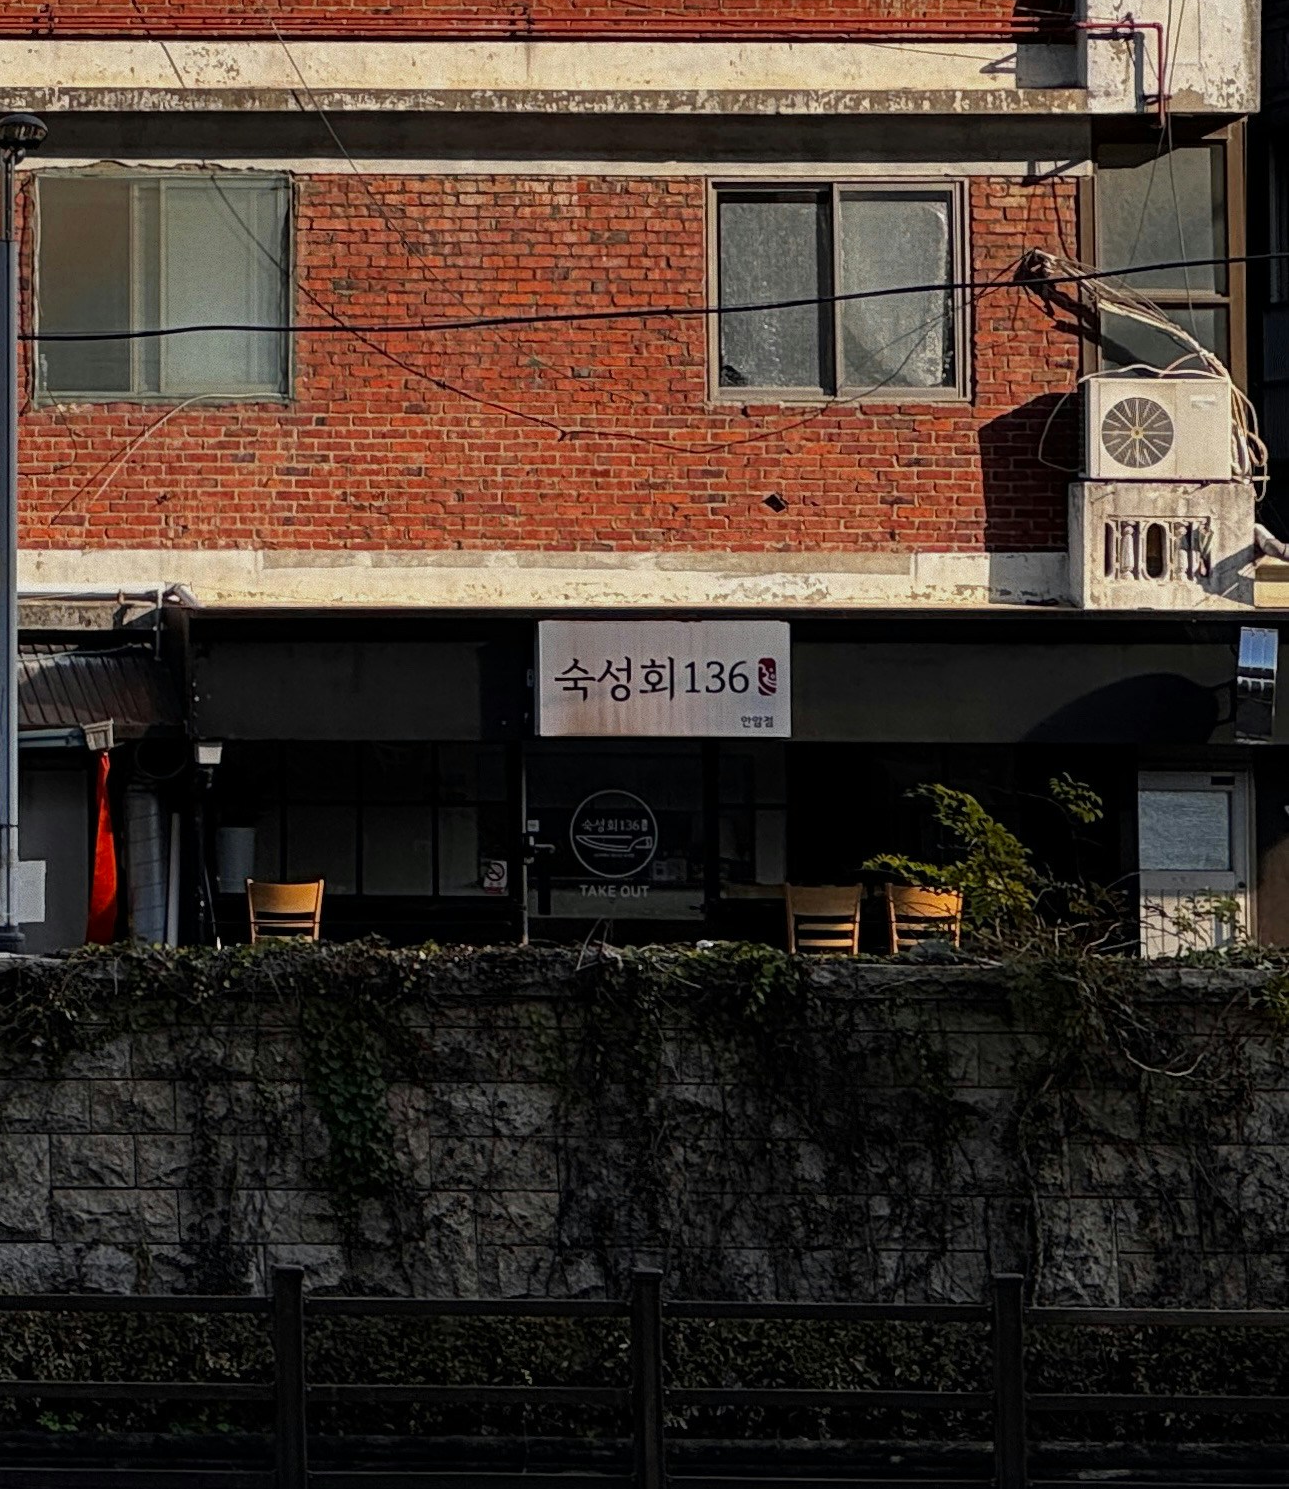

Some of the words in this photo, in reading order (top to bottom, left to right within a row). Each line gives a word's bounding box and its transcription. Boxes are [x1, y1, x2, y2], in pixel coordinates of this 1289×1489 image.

[740, 715, 774, 729] 안암점
[579, 884, 617, 898] TAKE
[620, 884, 650, 898] OUT
